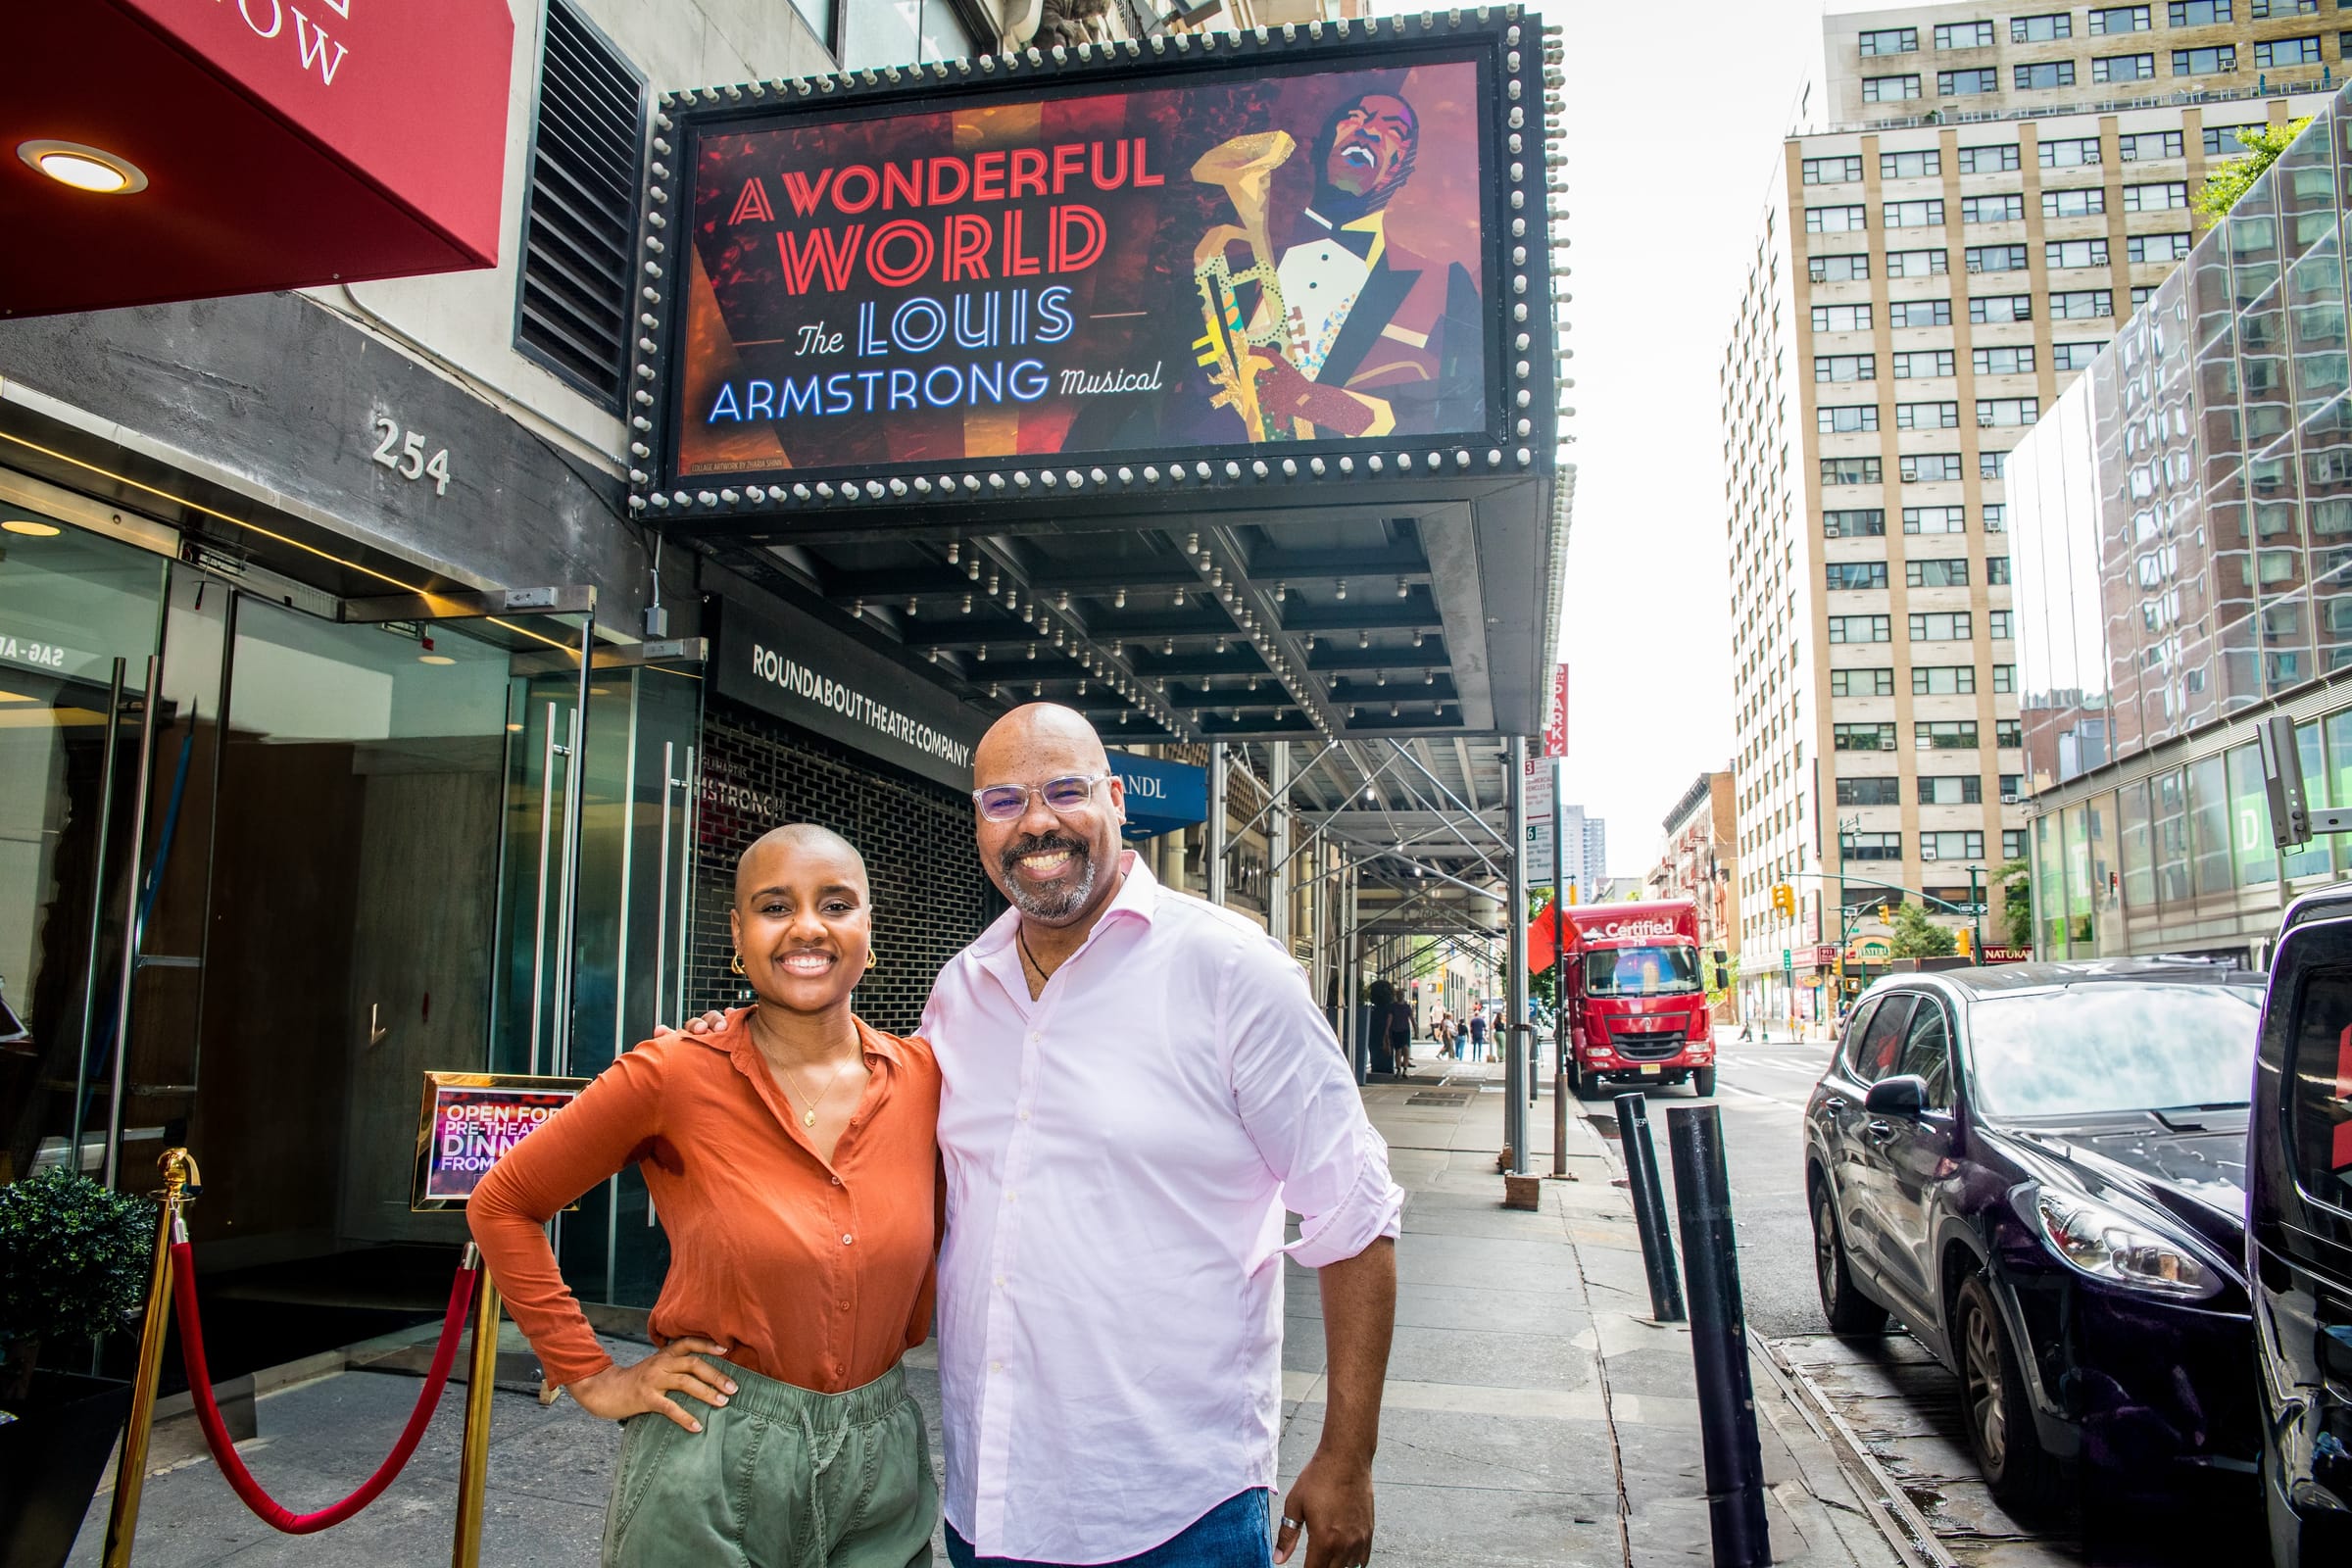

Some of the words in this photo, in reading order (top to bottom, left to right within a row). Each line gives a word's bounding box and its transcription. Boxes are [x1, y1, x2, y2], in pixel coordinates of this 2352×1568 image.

[235, 0, 349, 86] OW
[727, 176, 775, 226] A
[781, 137, 1165, 218] WONDERFUL
[776, 204, 1107, 296] WORLD
[795, 320, 845, 357] The
[858, 285, 1076, 358] LOUIS
[708, 359, 1051, 423] ARMSTRONG
[1059, 361, 1163, 396] Musical
[372, 417, 450, 496] 254
[753, 644, 863, 721] ROUNDABOUT
[864, 698, 915, 745] THEATRE
[916, 722, 969, 769] COMPANY
[1526, 760, 1534, 774] 3
[1527, 827, 1534, 840] 6
[1605, 918, 1673, 938] Certified
[446, 1104, 511, 1122] OPEN
[441, 1156, 495, 1171] FROM
[442, 1135, 520, 1157] DINN
